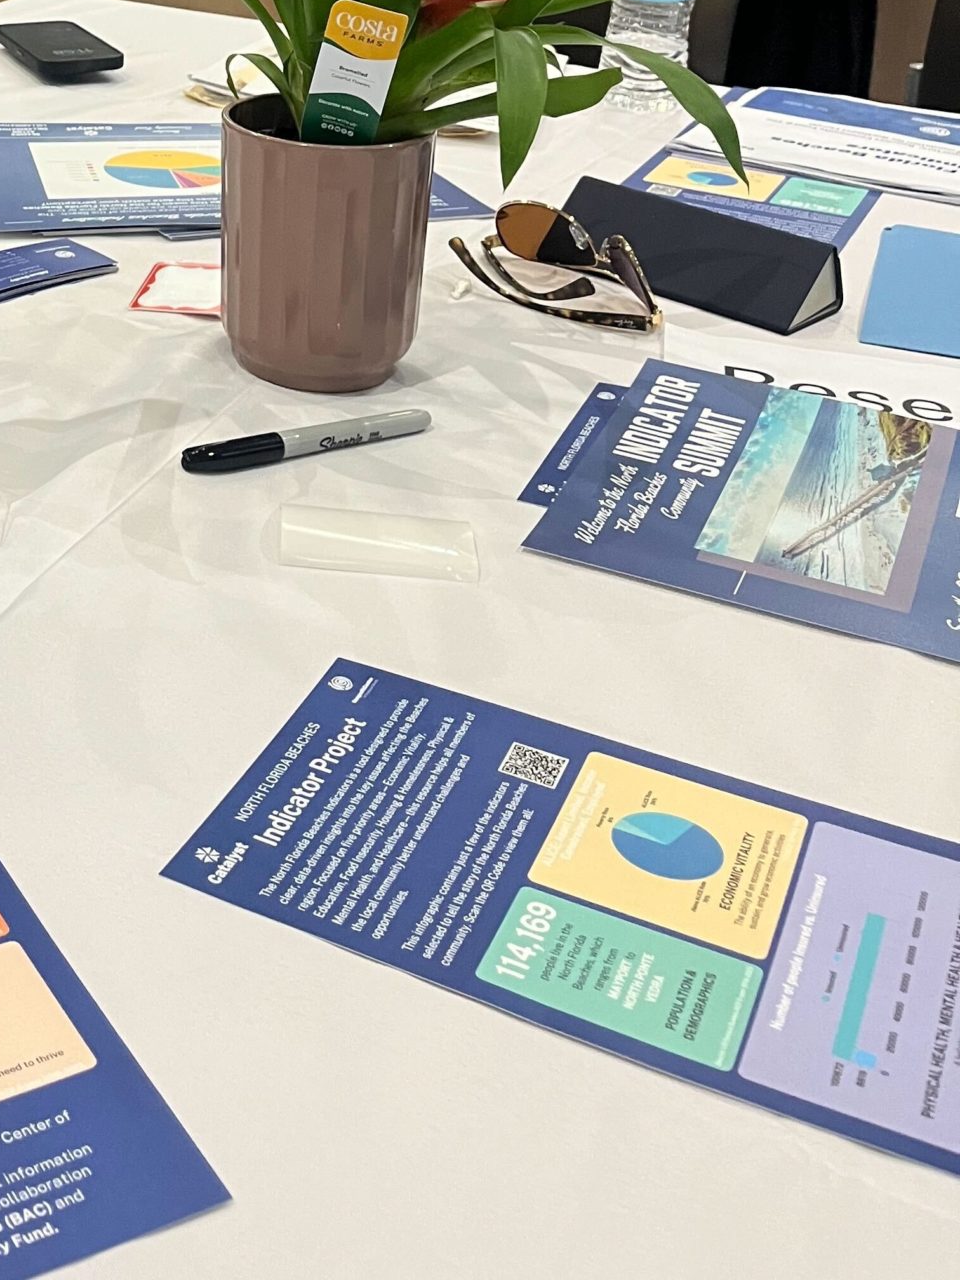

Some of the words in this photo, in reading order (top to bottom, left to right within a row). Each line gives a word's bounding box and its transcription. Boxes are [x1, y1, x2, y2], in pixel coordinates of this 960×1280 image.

[336, 12, 398, 42] costa
[343, 32, 383, 47] FARMS
[613, 375, 701, 464] INDICATOR
[672, 407, 746, 478] SUMMIT
[609, 462, 639, 489] North
[599, 499, 616, 509] to
[603, 488, 625, 501] the
[614, 504, 649, 533] Florida
[633, 472, 667, 504] Beaches
[660, 477, 704, 519] Community
[574, 507, 612, 544] Welcome
[405, 698, 429, 723] Beaches
[399, 723, 413, 733] the
[382, 733, 407, 762] affecting
[235, 792, 266, 822] NORTH
[258, 759, 293, 793] FLORIDA
[285, 723, 320, 759] BEACHES
[254, 773, 324, 846] Indicator
[310, 718, 366, 773] Project
[357, 781, 374, 794] key
[365, 761, 386, 781] issues
[259, 883, 277, 897] The
[270, 863, 292, 884] North
[285, 839, 310, 863] Florida
[303, 811, 331, 839] Beaches
[324, 779, 353, 811] Indicators
[355, 754, 371, 768] tool
[364, 727, 389, 756] designed
[390, 699, 409, 722] provide
[341, 804, 356, 818] into
[350, 793, 364, 804] the
[321, 818, 347, 845] insights
[208, 843, 248, 884] Catalyst
[294, 845, 328, 884] data-driven
[719, 867, 744, 911] ECONOMIC
[735, 832, 755, 866] VITALITY
[280, 885, 301, 905] clear,
[497, 902, 556, 979] 114,169
[684, 973, 716, 1041] DEMOGRAPHICS
[1, 1119, 50, 1143] Center
[55, 1110, 70, 1124] of
[4, 1146, 92, 1184] information
[5, 1202, 52, 1229] (BAC)
[55, 1189, 85, 1209] and
[11, 1223, 59, 1248] Fund.
